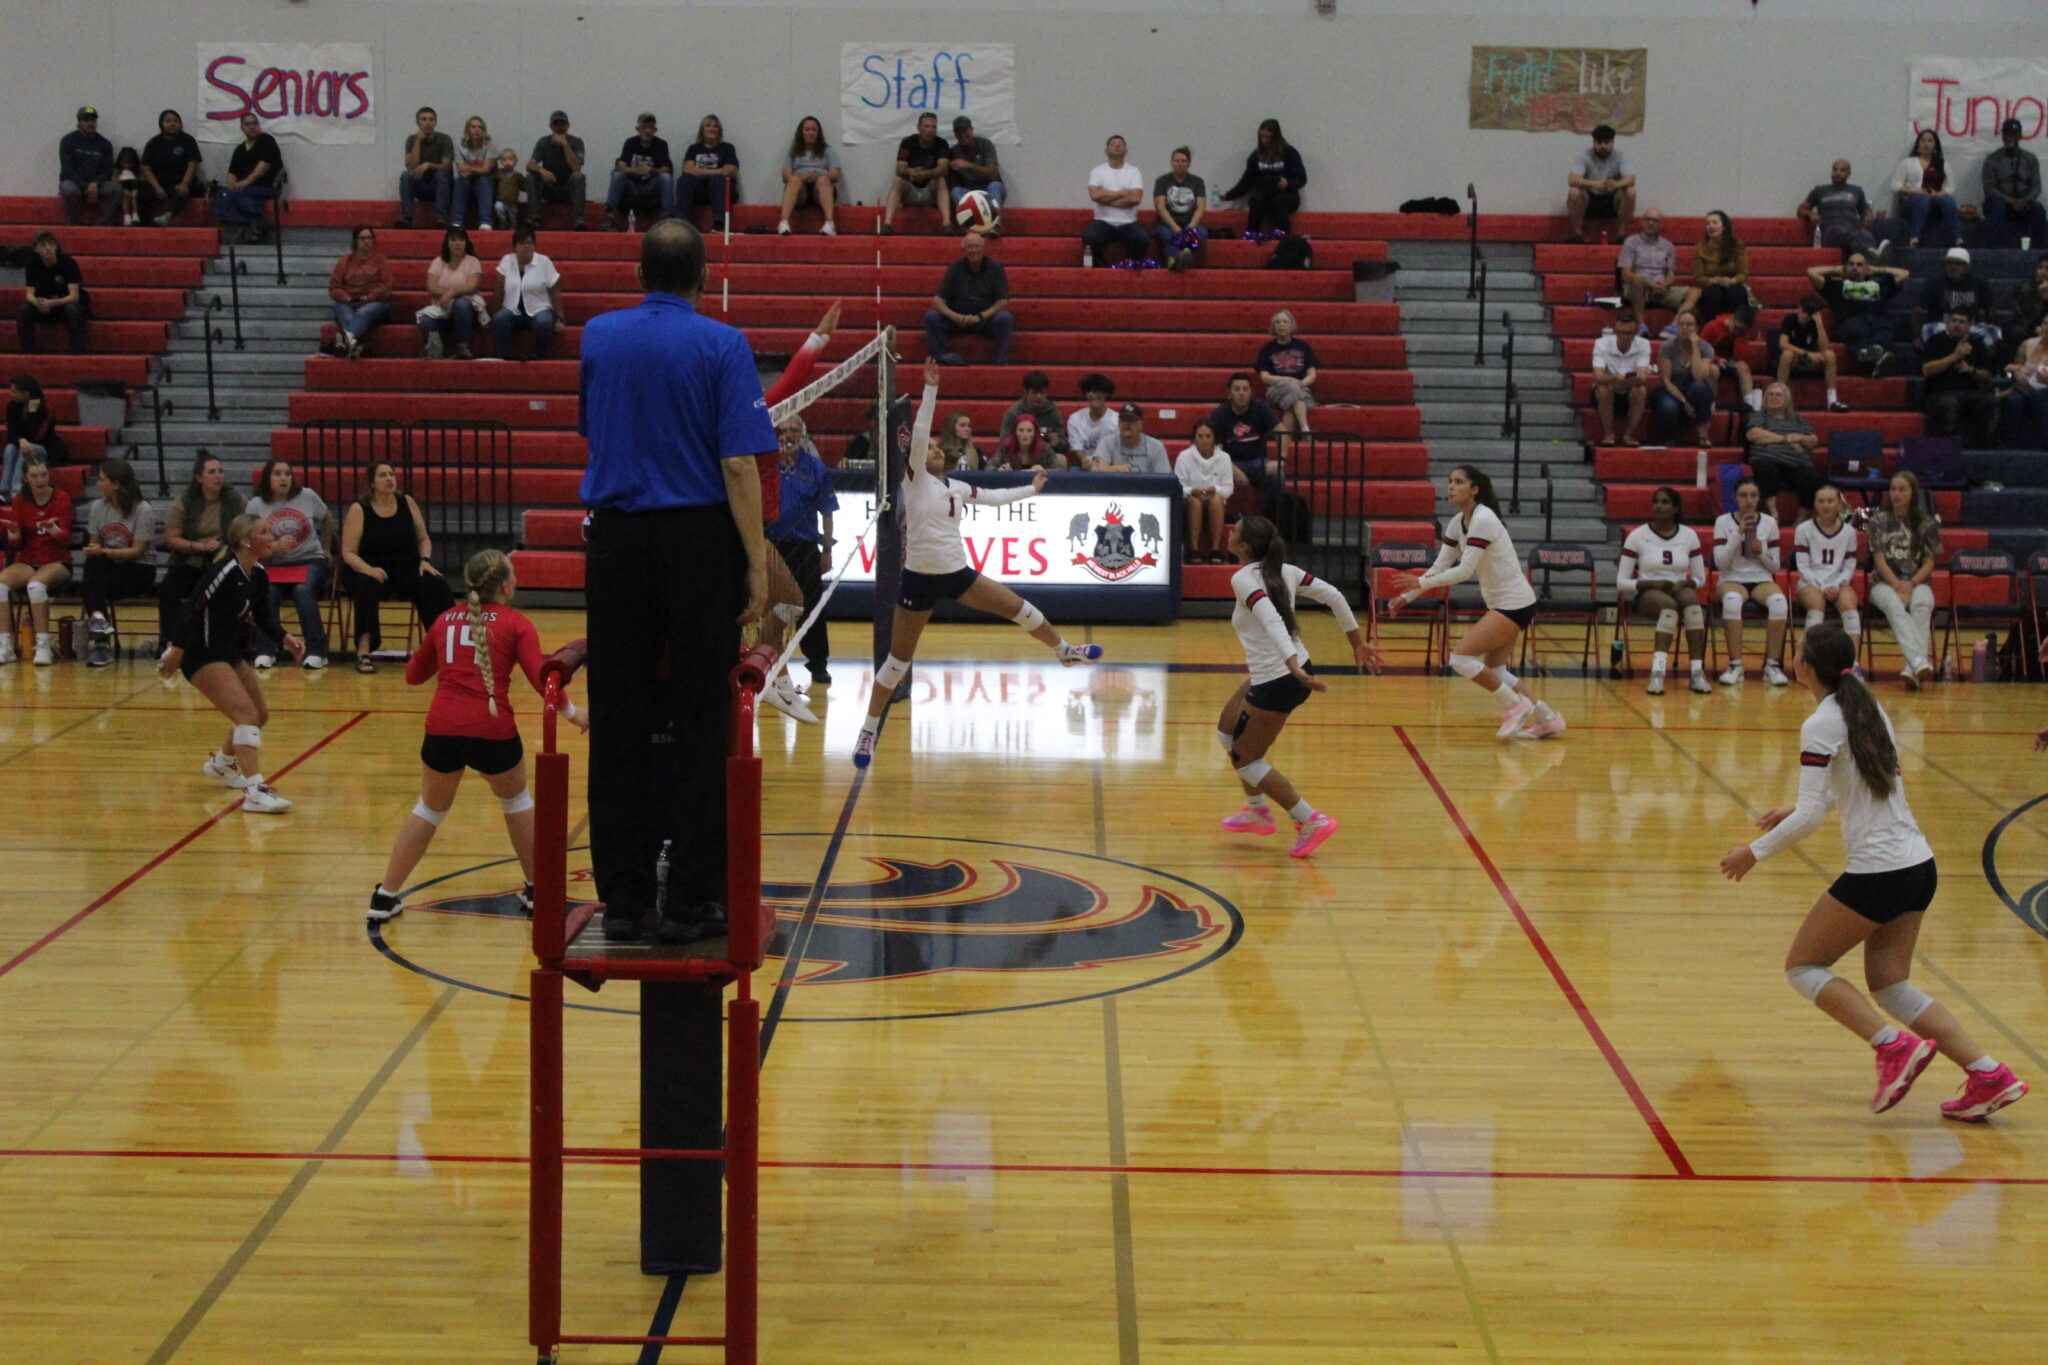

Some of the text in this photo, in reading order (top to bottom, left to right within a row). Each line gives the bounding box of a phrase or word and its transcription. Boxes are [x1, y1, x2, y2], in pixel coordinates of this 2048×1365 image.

[206, 55, 369, 119] Seniors
[861, 52, 974, 110] Staff
[1484, 51, 1557, 104] Fight
[1913, 77, 2048, 140] Junio
[856, 535, 1049, 576] WVES
[1662, 550, 1673, 565] 9
[1821, 549, 1834, 564] 11
[445, 611, 498, 622] VIKIGS
[446, 625, 487, 664] 14
